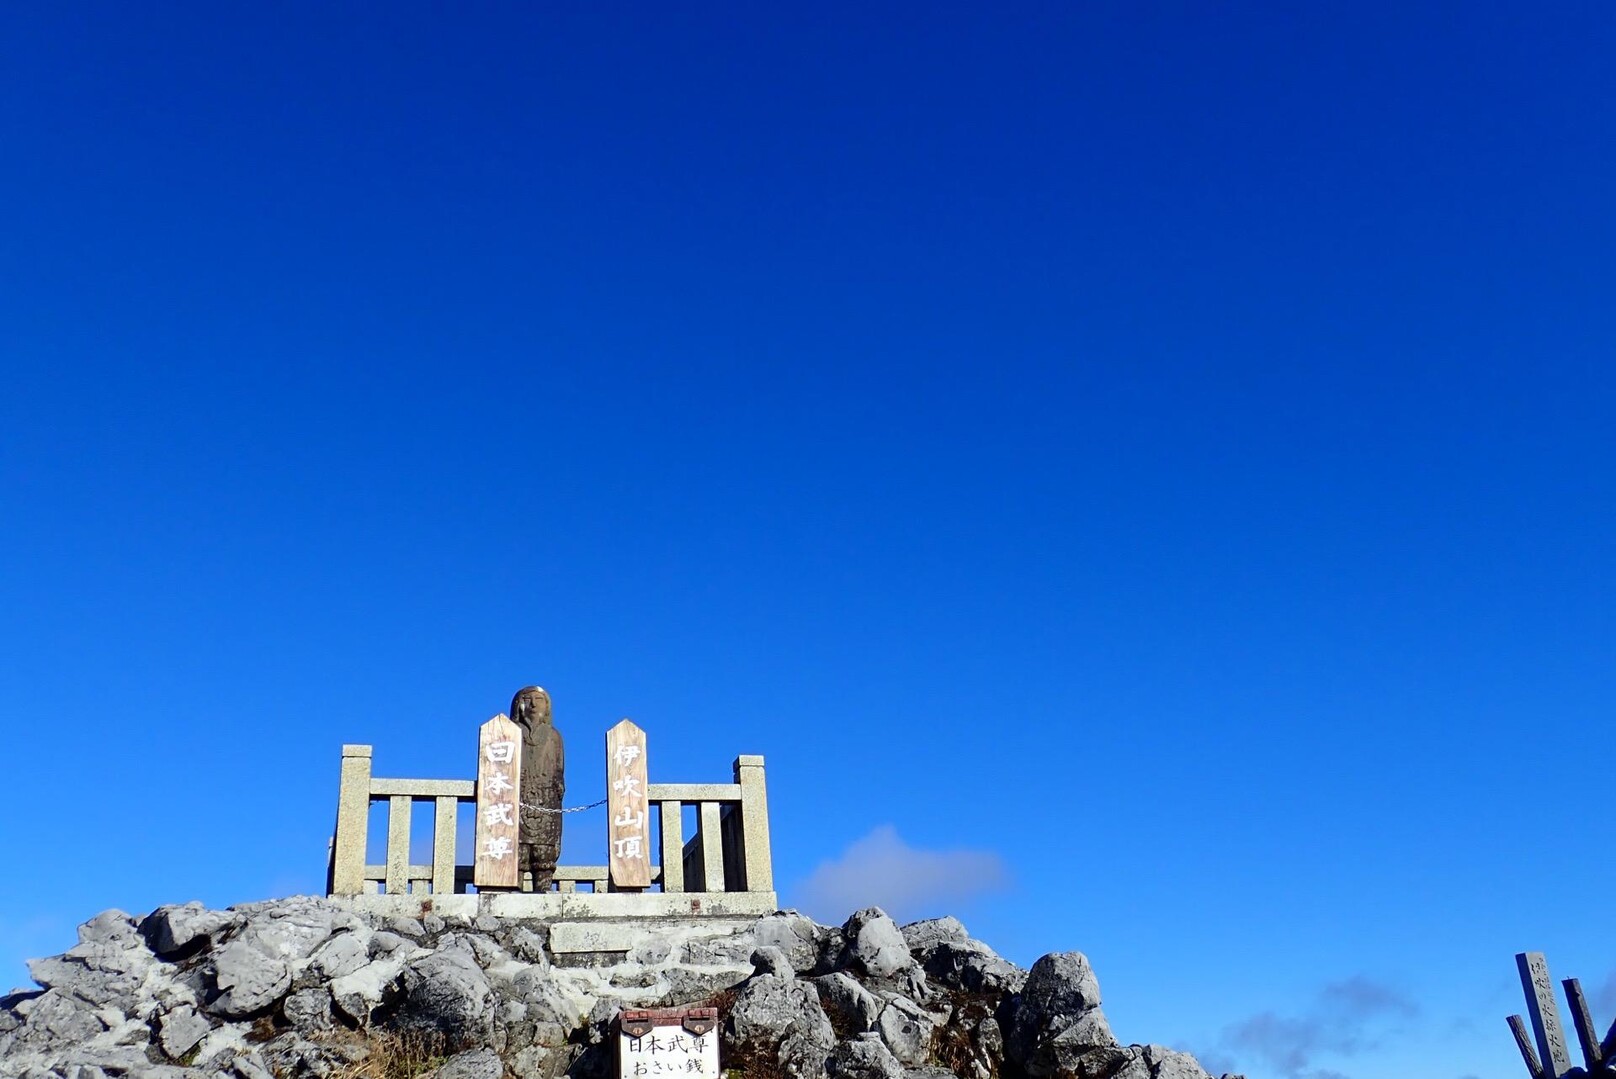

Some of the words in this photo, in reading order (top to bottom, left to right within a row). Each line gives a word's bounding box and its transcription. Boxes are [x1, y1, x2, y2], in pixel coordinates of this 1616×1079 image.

[482, 741, 515, 860] 日本武尊
[613, 744, 644, 859] 伊吹山頂
[629, 1035, 709, 1055] 日本武尊
[633, 1058, 704, 1076] おさい銭
